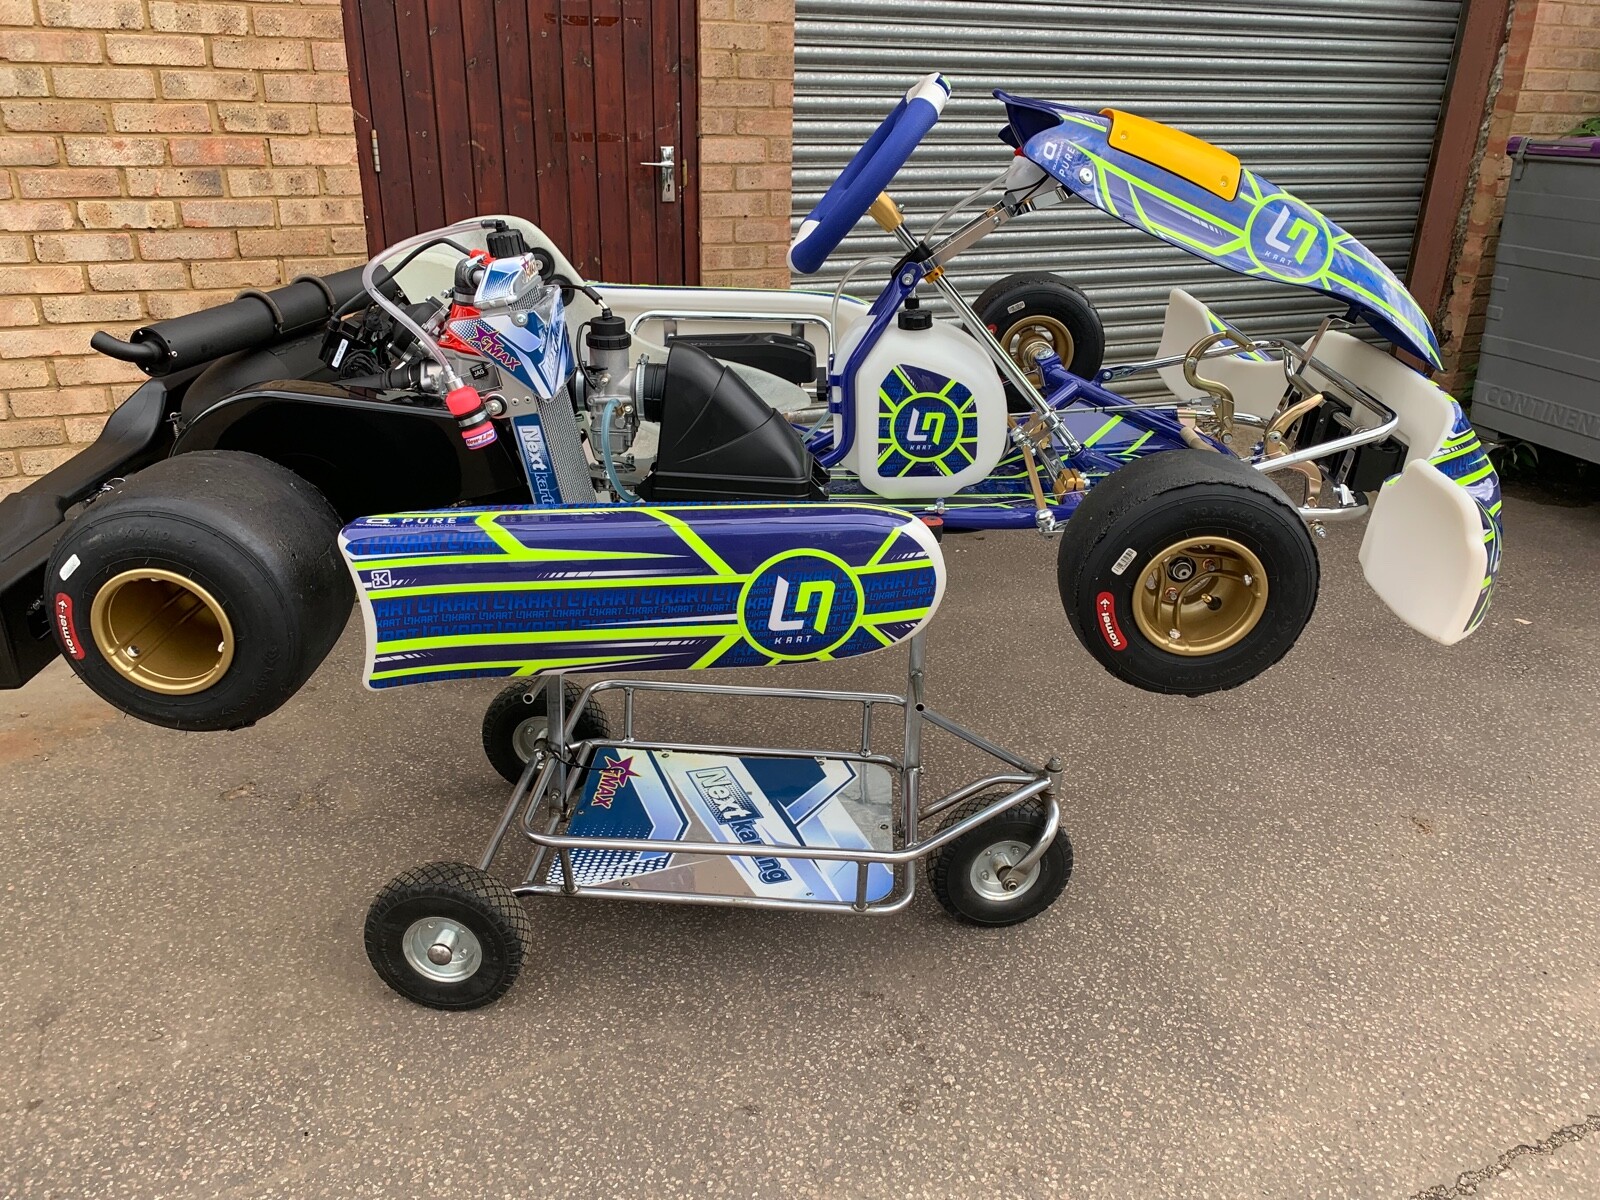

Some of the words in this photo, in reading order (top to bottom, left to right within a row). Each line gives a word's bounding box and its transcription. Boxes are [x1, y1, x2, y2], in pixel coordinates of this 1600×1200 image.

[1058, 147, 1076, 178] PURE
[1264, 250, 1293, 266] KART
[522, 427, 548, 470] Next
[402, 517, 458, 525] PURE
[58, 613, 78, 655] komet
[774, 635, 812, 645] KART
[1101, 611, 1121, 647] komet
[696, 769, 752, 819] Next
[728, 819, 793, 884] kang
